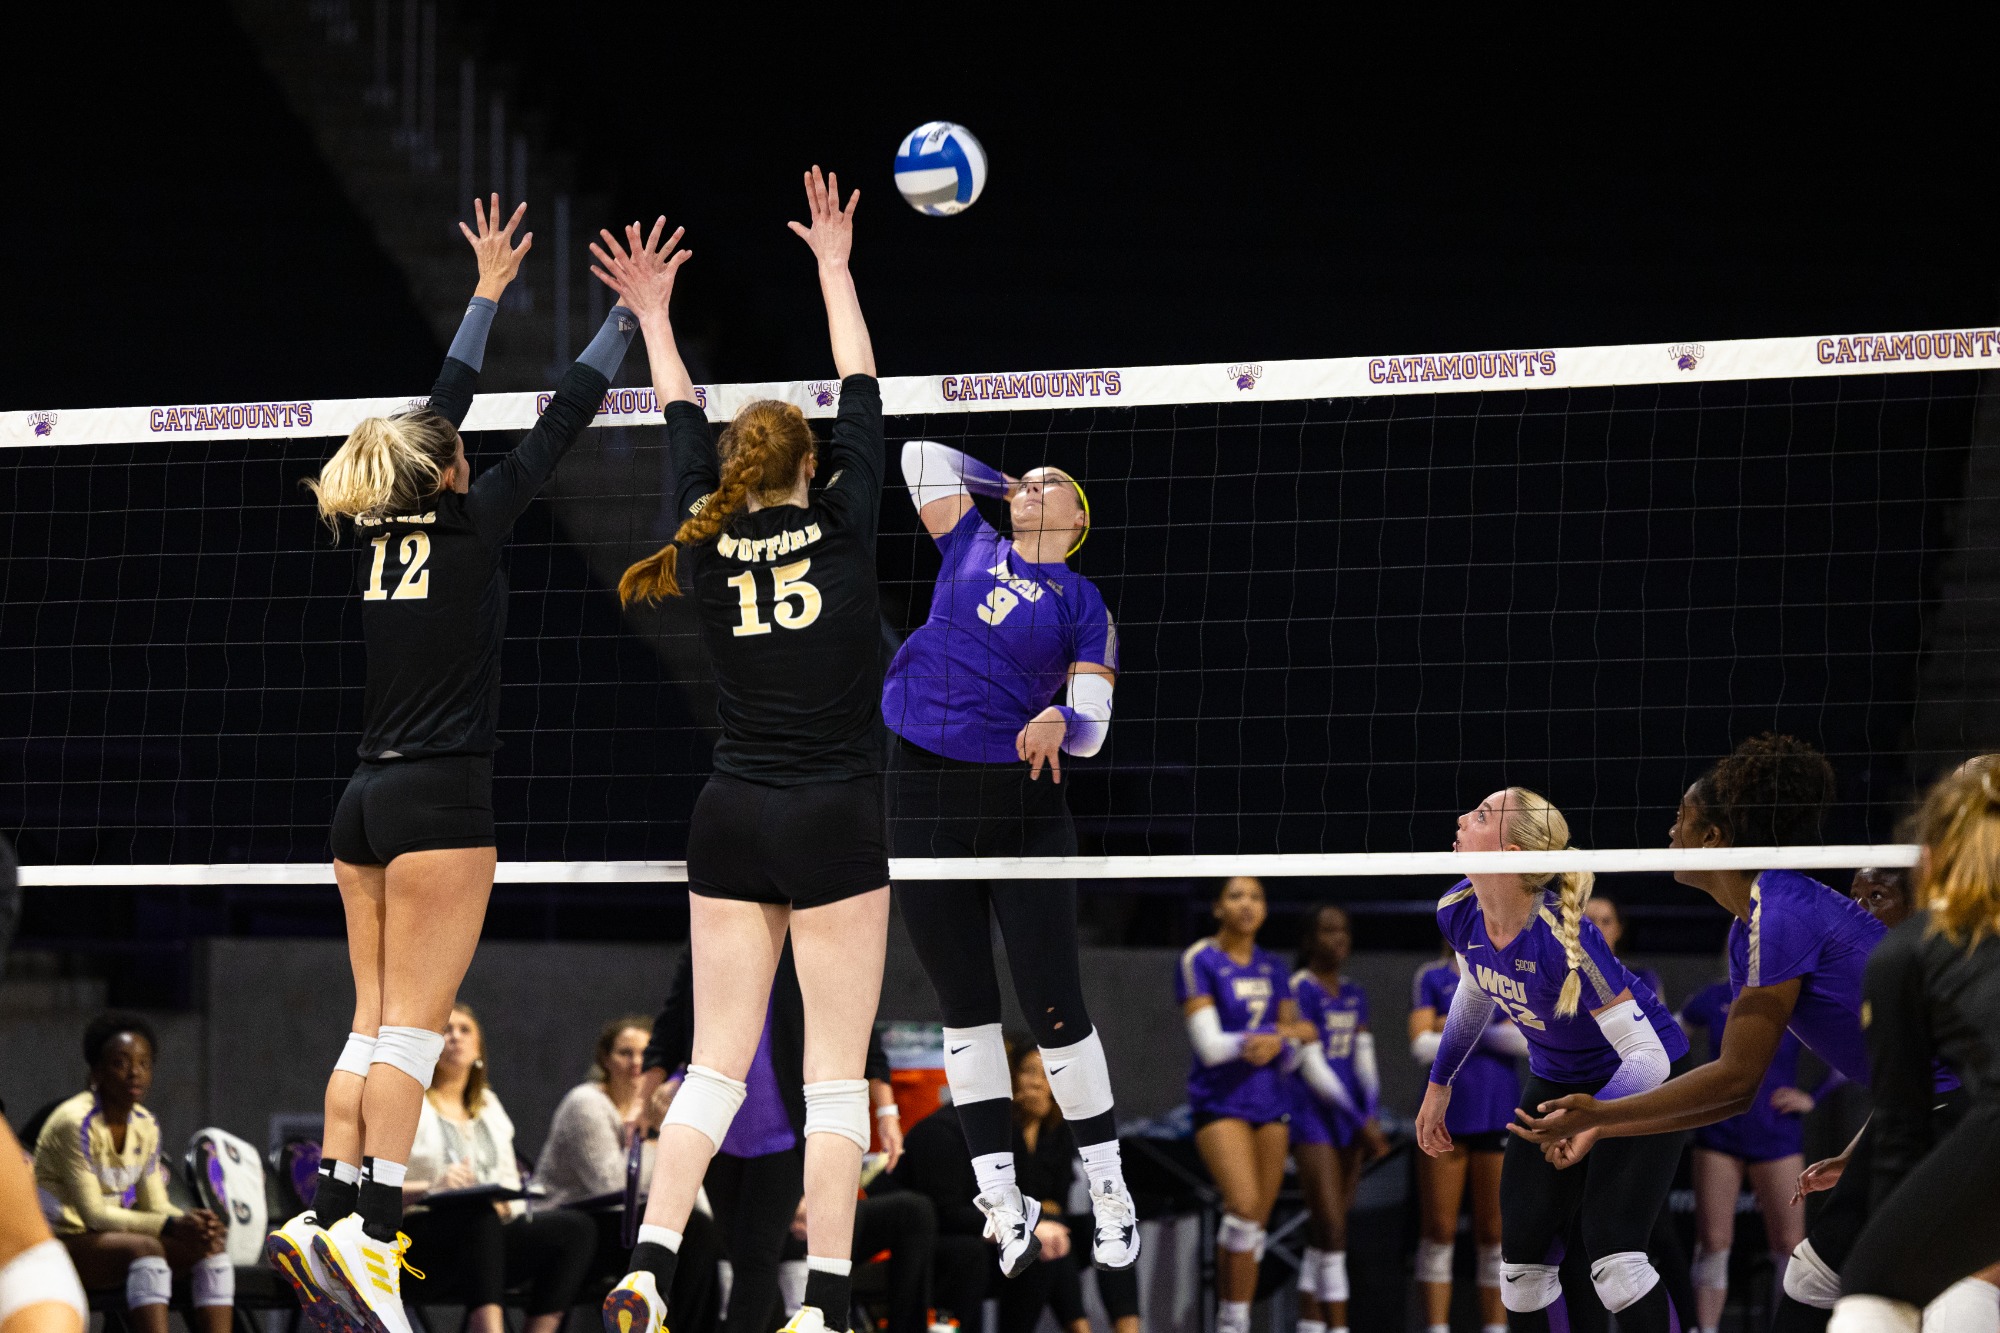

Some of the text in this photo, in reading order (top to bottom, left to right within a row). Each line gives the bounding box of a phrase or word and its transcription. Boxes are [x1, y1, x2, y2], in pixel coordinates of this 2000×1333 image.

[1667, 343, 1705, 360] WCU
[1816, 330, 2000, 364] CATAMOUNT
[1226, 363, 1263, 381] WCU
[1368, 350, 1557, 384] CATAMOUNTS
[941, 370, 1122, 402] CATAMOUNTS
[26, 411, 58, 427] WCU
[149, 402, 313, 433] CATAMOUNTS
[362, 530, 431, 601] 12
[726, 556, 823, 638] 15
[975, 585, 1020, 627] 9
[1475, 963, 1528, 1005] WCU
